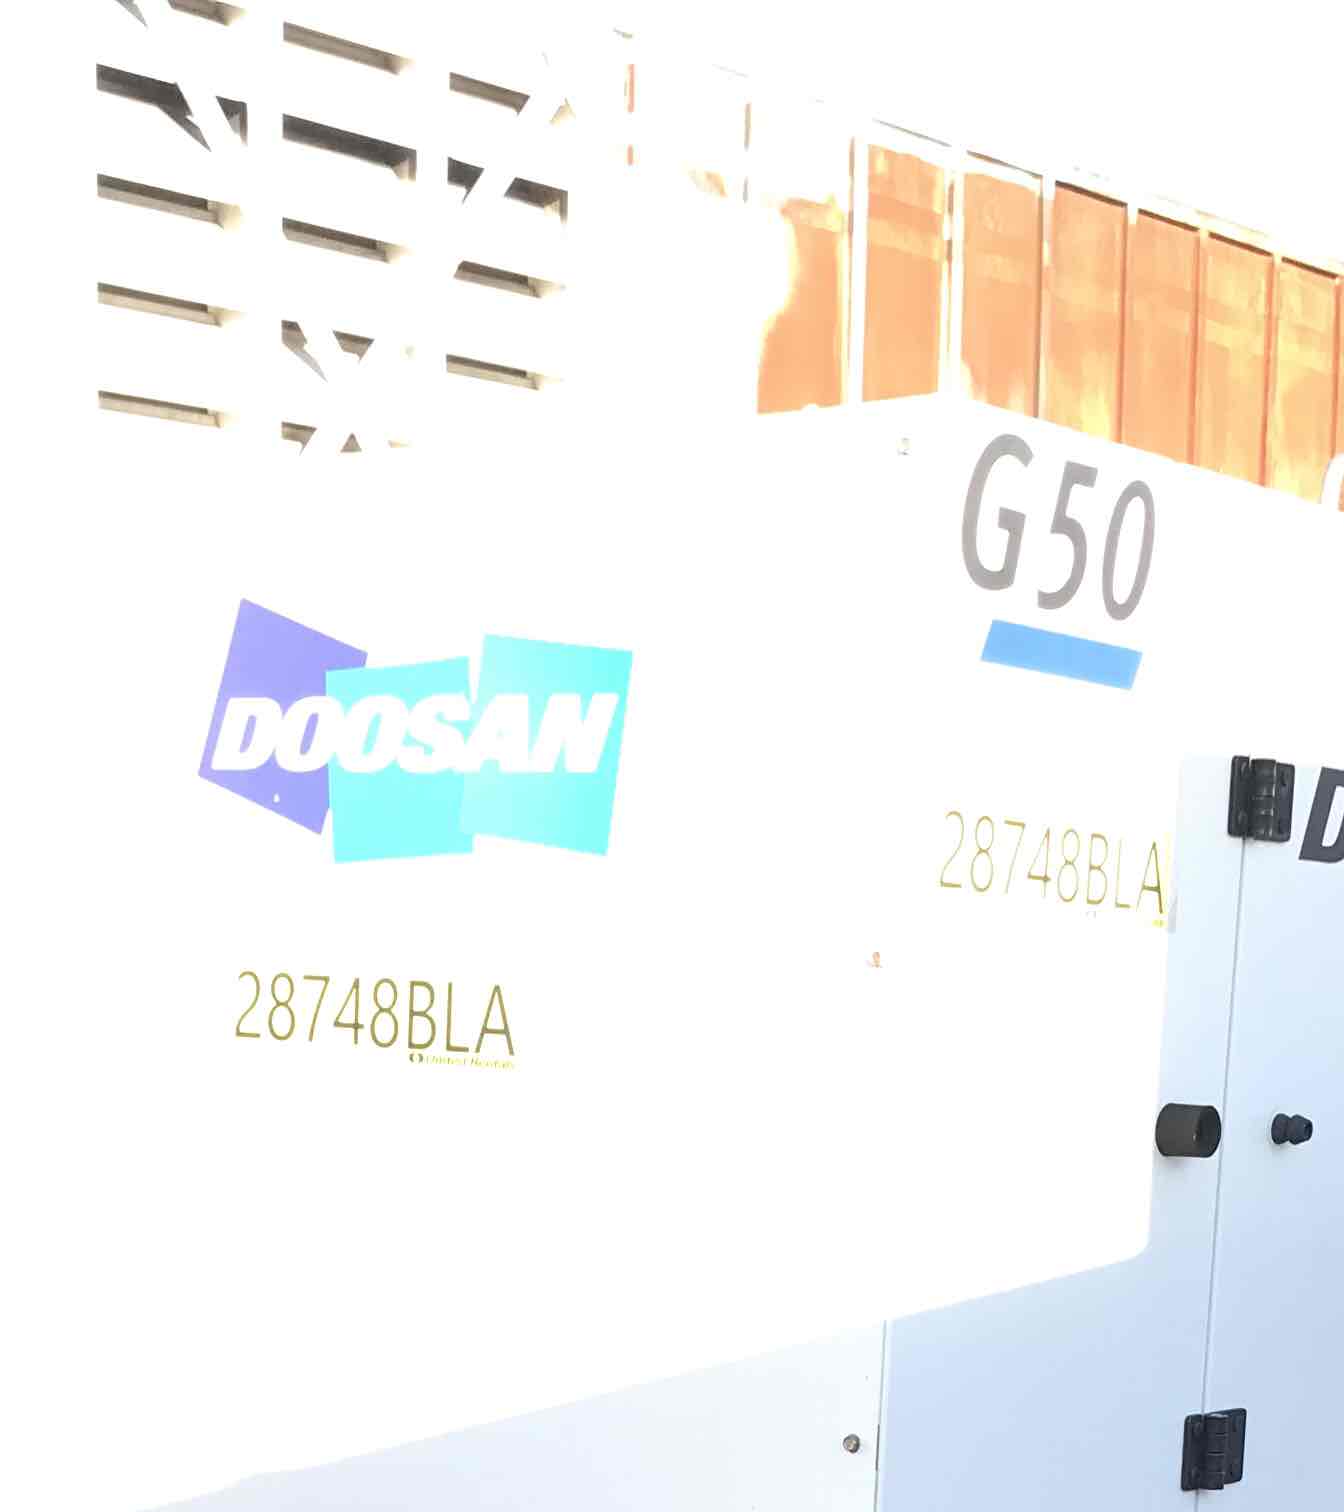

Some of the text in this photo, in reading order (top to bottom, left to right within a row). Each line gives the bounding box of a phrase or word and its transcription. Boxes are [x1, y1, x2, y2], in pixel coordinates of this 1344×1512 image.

[961, 433, 1156, 622] G50
[210, 693, 620, 774] DOOSAN
[940, 810, 1164, 915] 28748BLA
[234, 970, 516, 1057] 28748BLA
